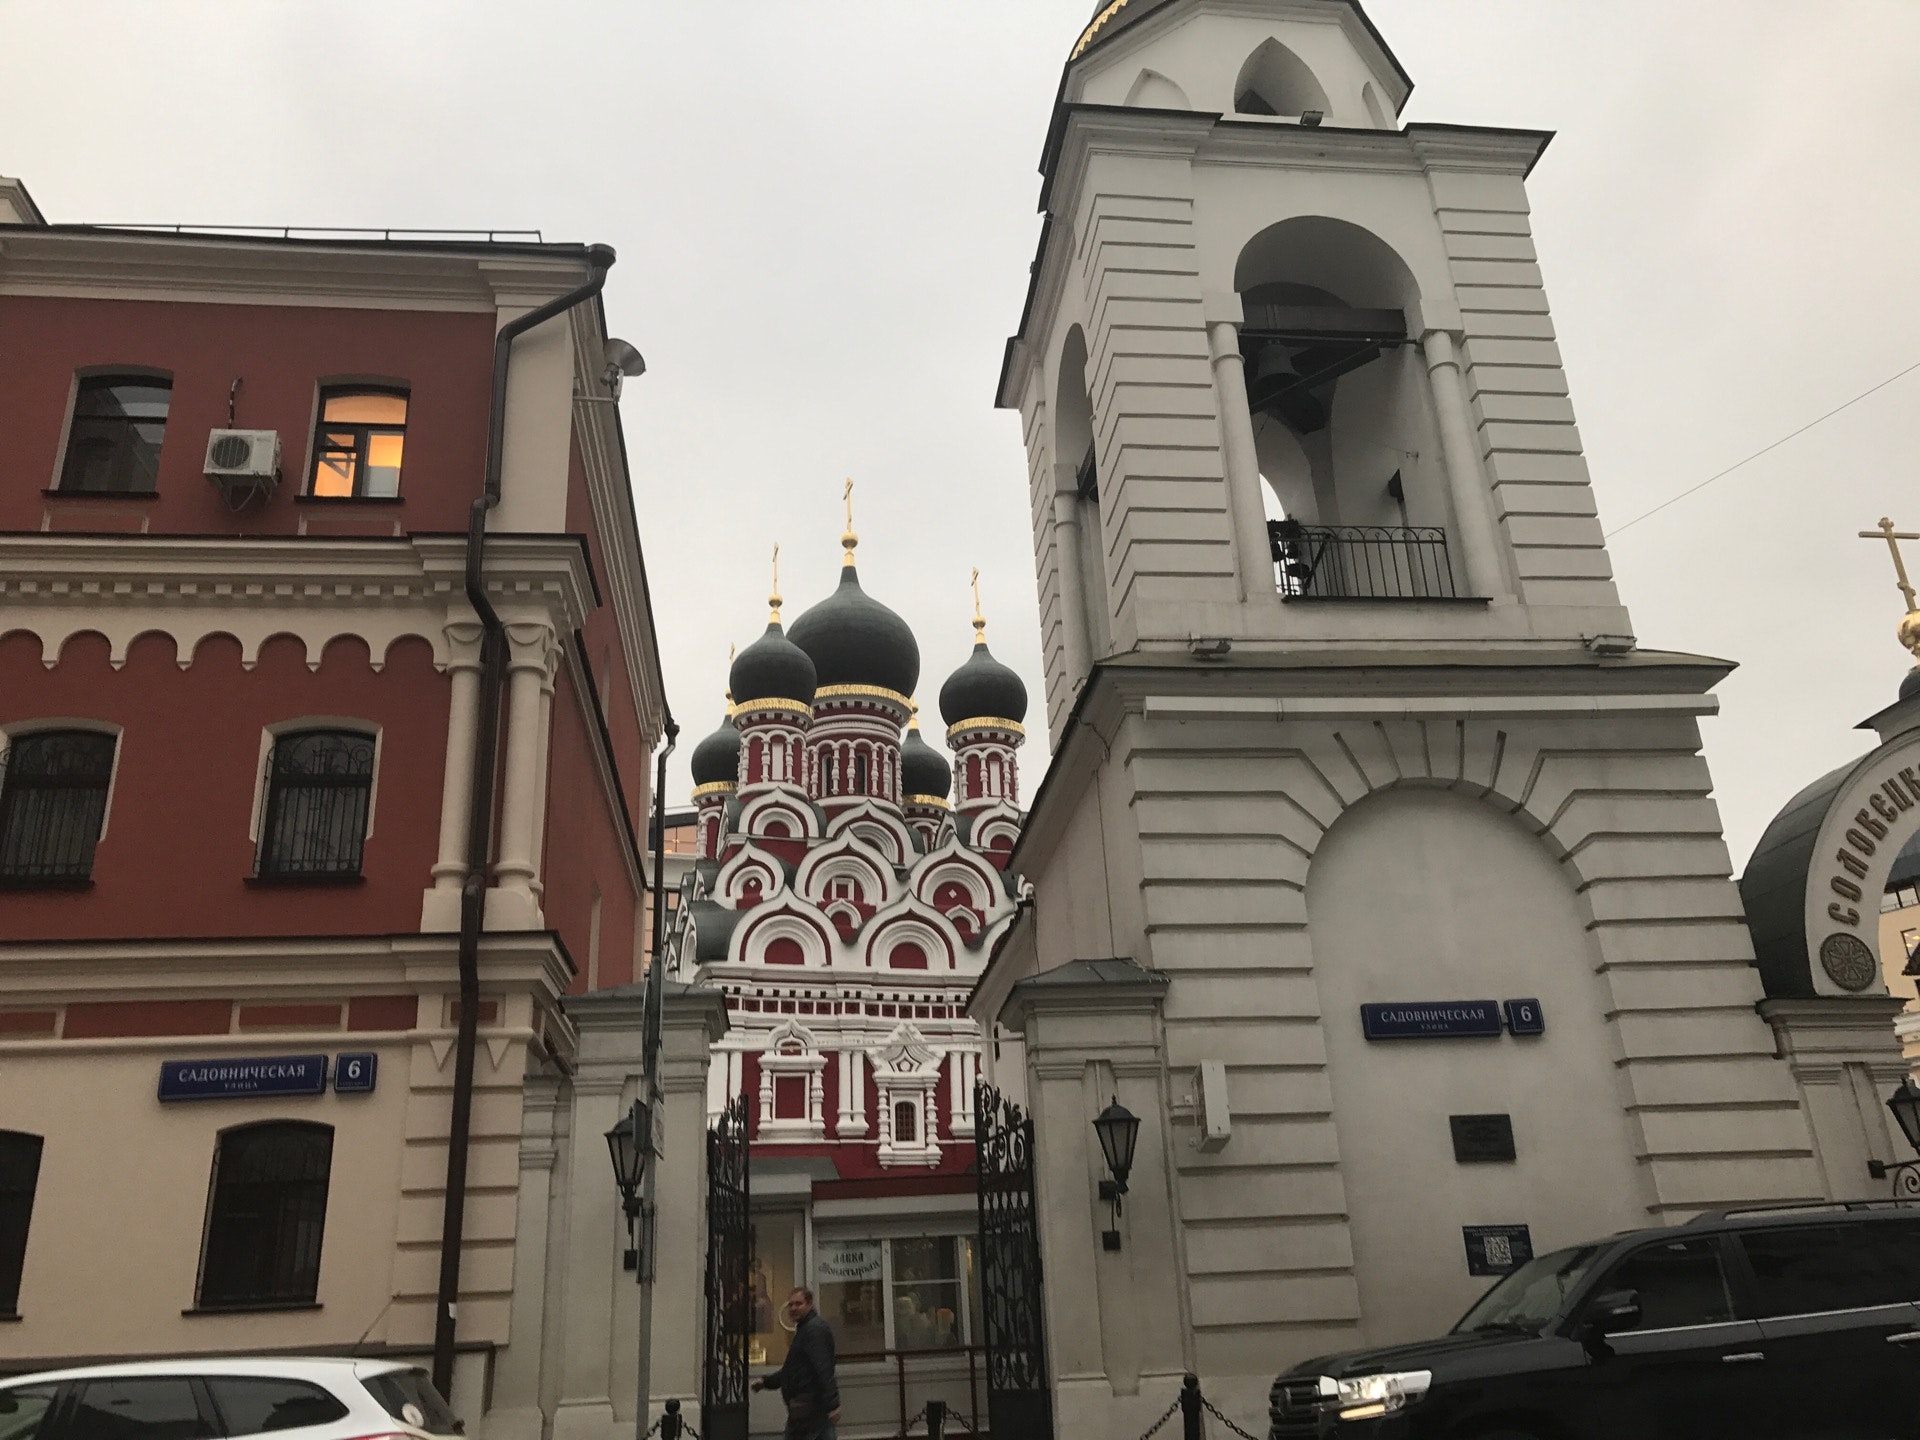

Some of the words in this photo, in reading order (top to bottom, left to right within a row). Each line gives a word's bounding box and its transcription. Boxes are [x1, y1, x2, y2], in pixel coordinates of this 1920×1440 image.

[1828, 764, 1920, 927] СОЛОВЕЦК
[1381, 1009, 1485, 1023] САДОВНИЧЕСКАЯ
[1520, 1005, 1532, 1023] 6
[178, 1064, 305, 1082] САДОВНИЧЕСКАЯ
[347, 1060, 361, 1079] 6
[224, 1082, 258, 1090] УЛИЦА
